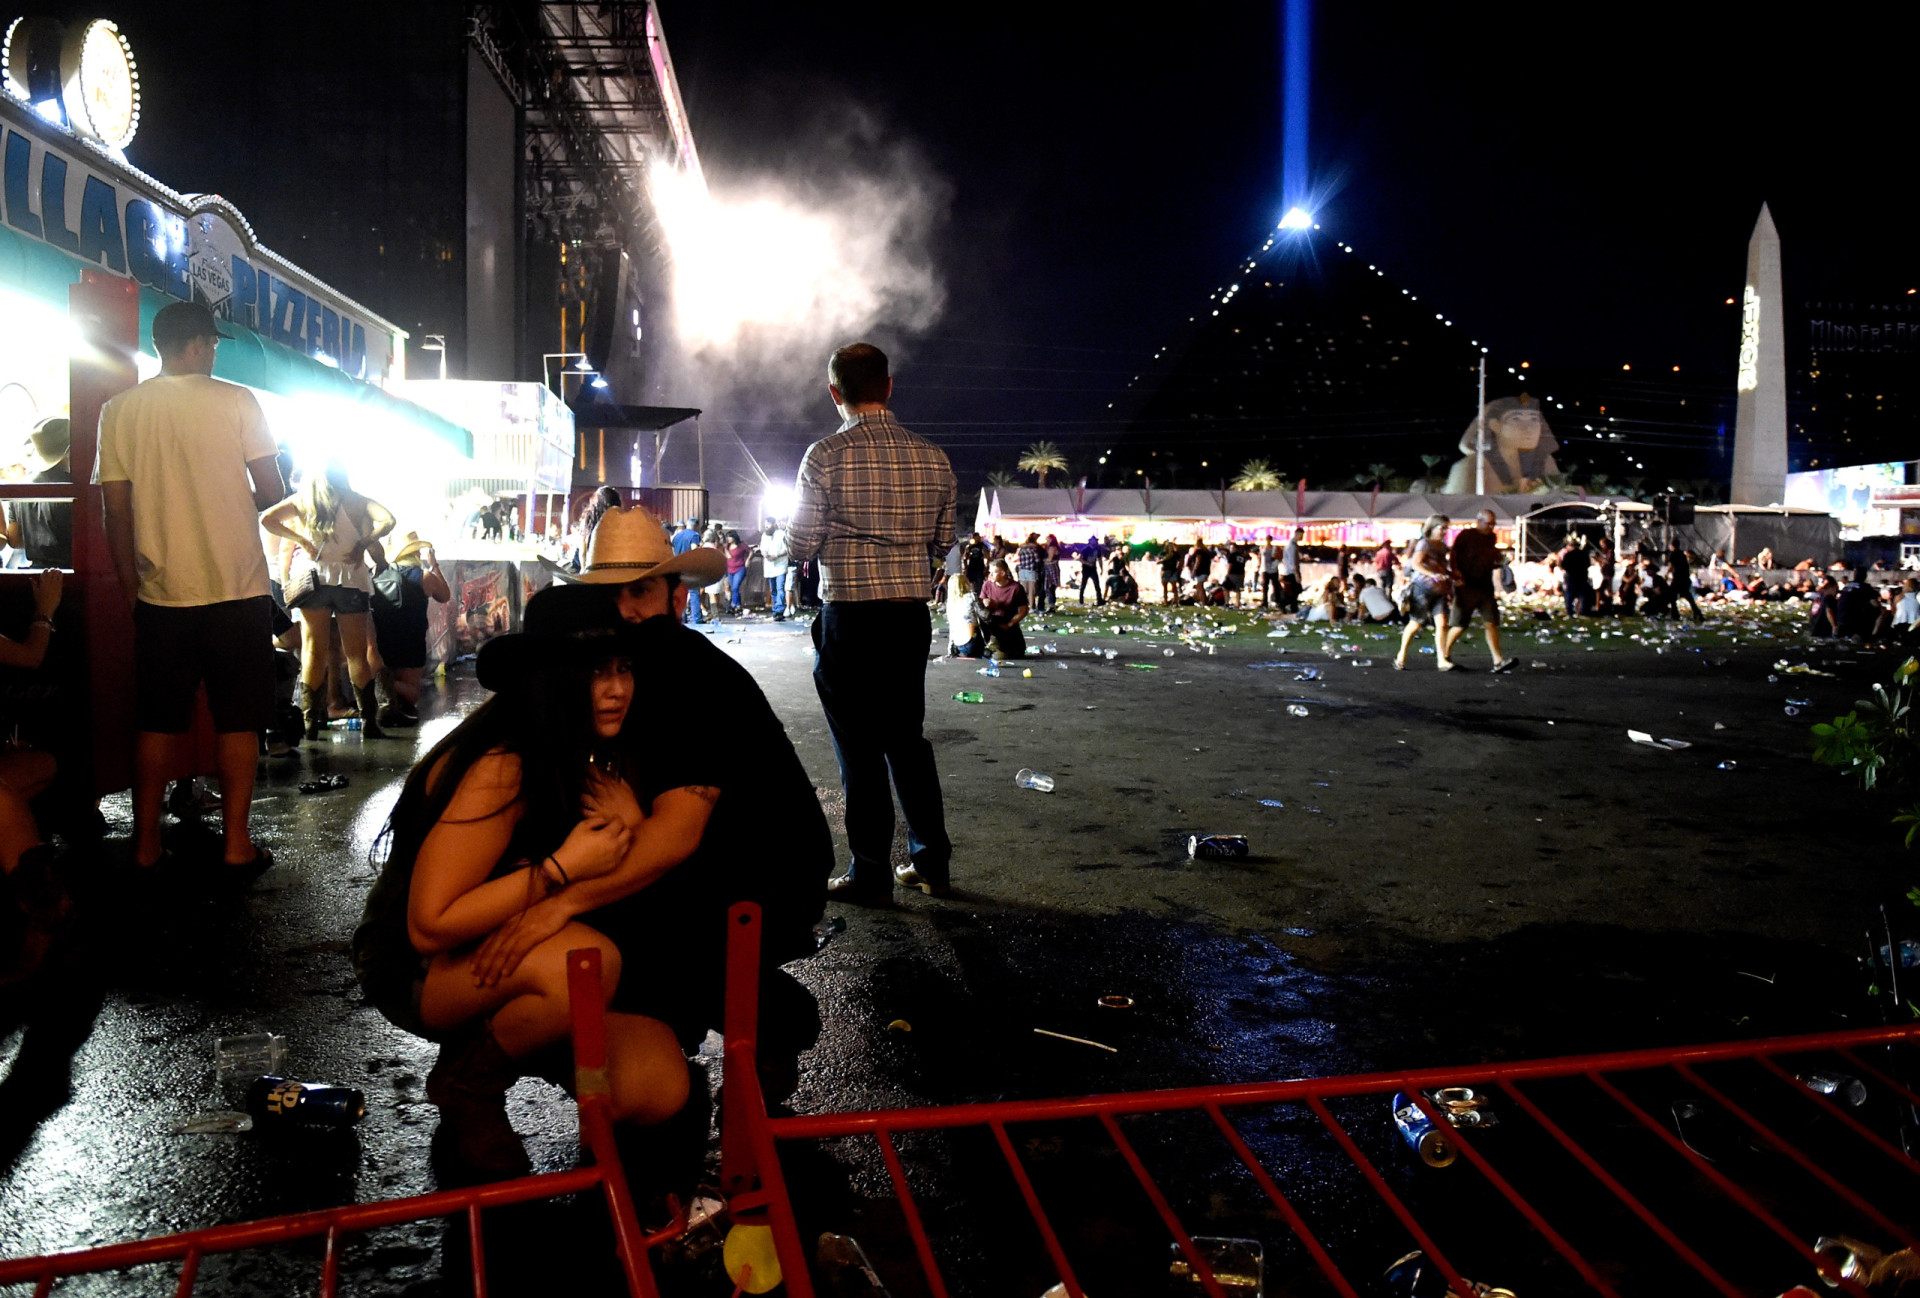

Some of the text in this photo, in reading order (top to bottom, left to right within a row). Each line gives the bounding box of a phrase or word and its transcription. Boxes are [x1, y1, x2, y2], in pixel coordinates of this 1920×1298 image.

[0, 124, 367, 382] LLAGE PIZZERIA
[192, 262, 207, 282] LAS
[208, 269, 231, 293] VEGAS
[1738, 285, 1760, 391] LUXOR
